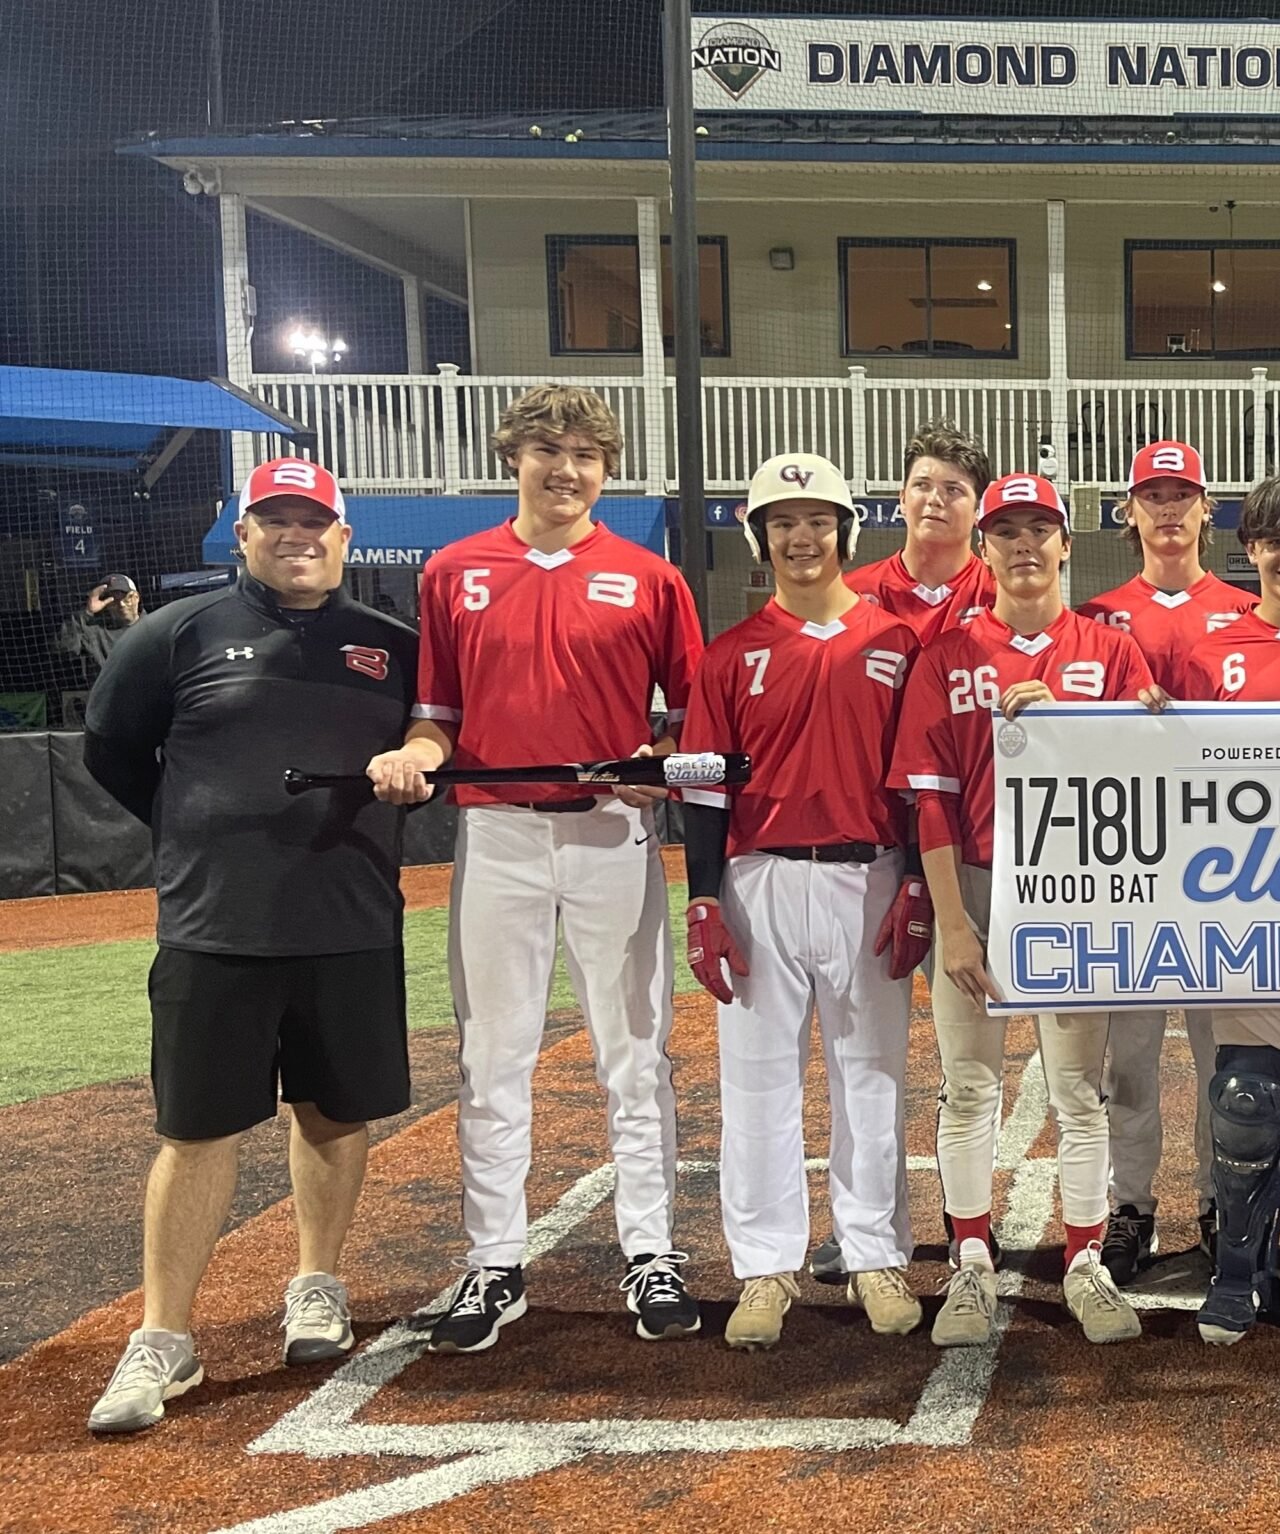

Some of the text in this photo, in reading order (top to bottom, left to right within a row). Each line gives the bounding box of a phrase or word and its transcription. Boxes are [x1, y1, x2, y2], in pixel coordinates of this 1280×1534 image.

[709, 37, 761, 47] DIAMOND
[691, 47, 780, 69] NATION
[807, 42, 1078, 88] DIAMOND
[780, 464, 815, 490] GV
[65, 526, 93, 535] FIELD
[75, 539, 85, 555] 4
[463, 568, 491, 612] 5
[743, 648, 772, 696] 7
[1223, 652, 1246, 692] 6
[948, 664, 1000, 714] 26
[667, 761, 722, 770] HOME RUN
[667, 768, 725, 781] classic
[1005, 776, 1167, 867] 17-18U
[1016, 873, 1159, 905] WOOD BAT
